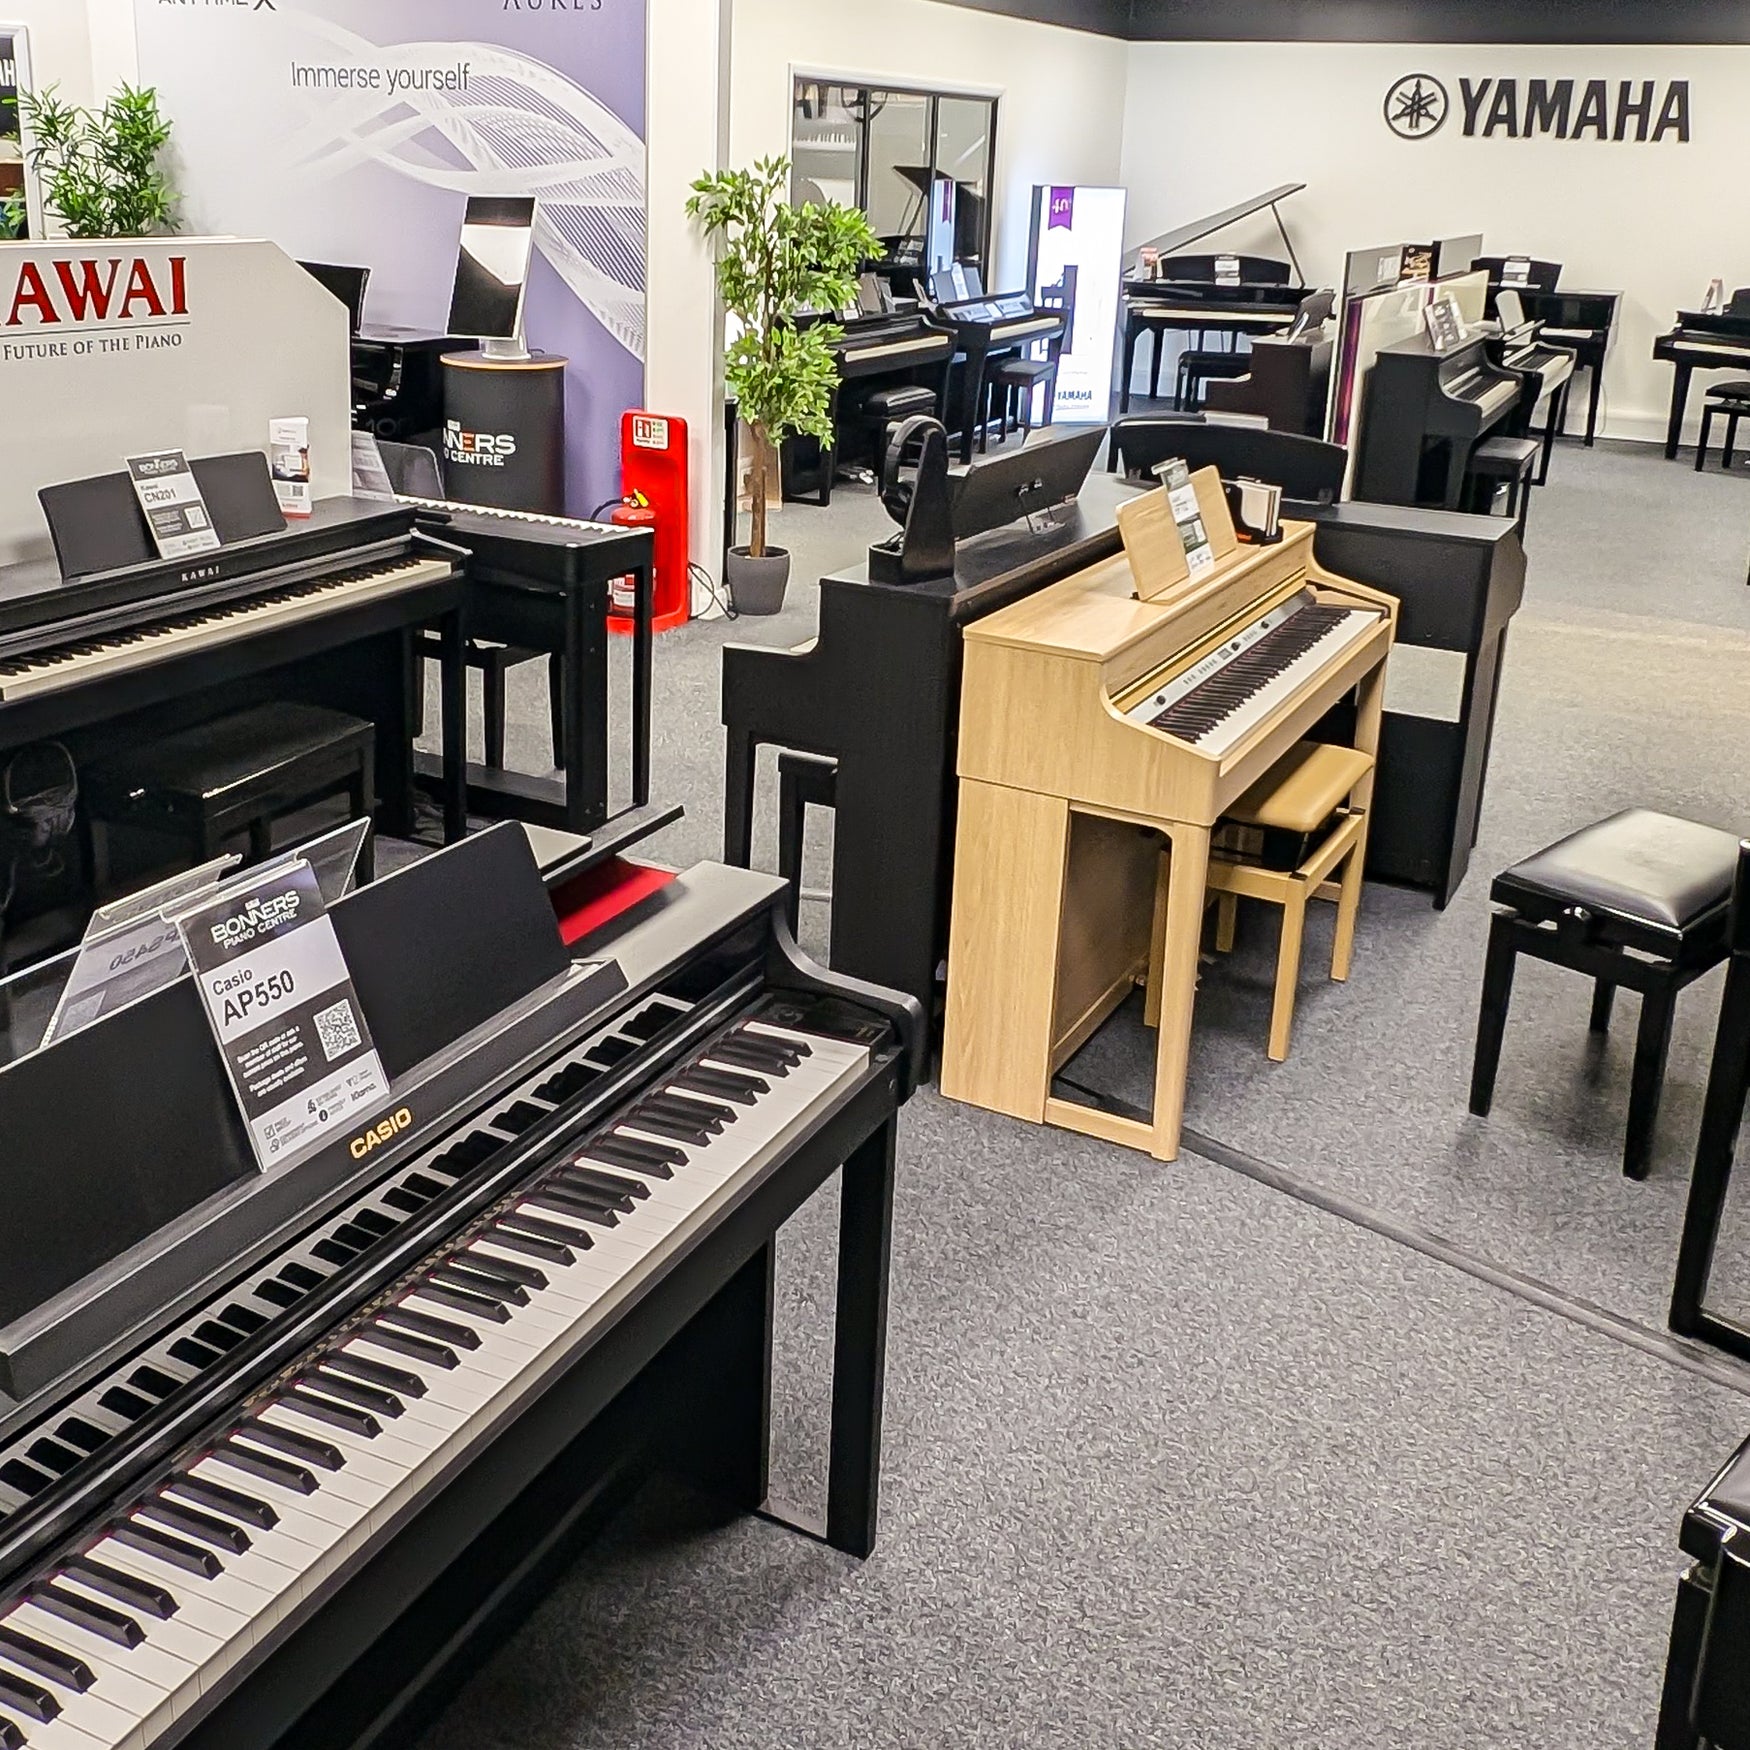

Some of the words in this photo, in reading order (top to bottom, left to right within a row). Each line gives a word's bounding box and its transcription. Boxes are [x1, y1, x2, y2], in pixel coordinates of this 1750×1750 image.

[291, 62, 380, 88] Immerse
[386, 62, 470, 96] yourself
[1459, 78, 1690, 142] YAMAHA
[0, 257, 188, 326] AWAI
[4, 342, 68, 360] FUTURE
[73, 340, 94, 354] OF
[99, 338, 130, 352] THE
[136, 333, 182, 350] PIANO
[450, 449, 504, 466] CENTRE
[182, 566, 220, 582] KAWAI
[210, 890, 300, 943] BONNERS
[224, 928, 256, 949] PIANO
[257, 908, 298, 933] CENTRE
[212, 970, 253, 996] Casio
[225, 970, 294, 1026] AP550
[350, 1108, 412, 1158] CASIO
